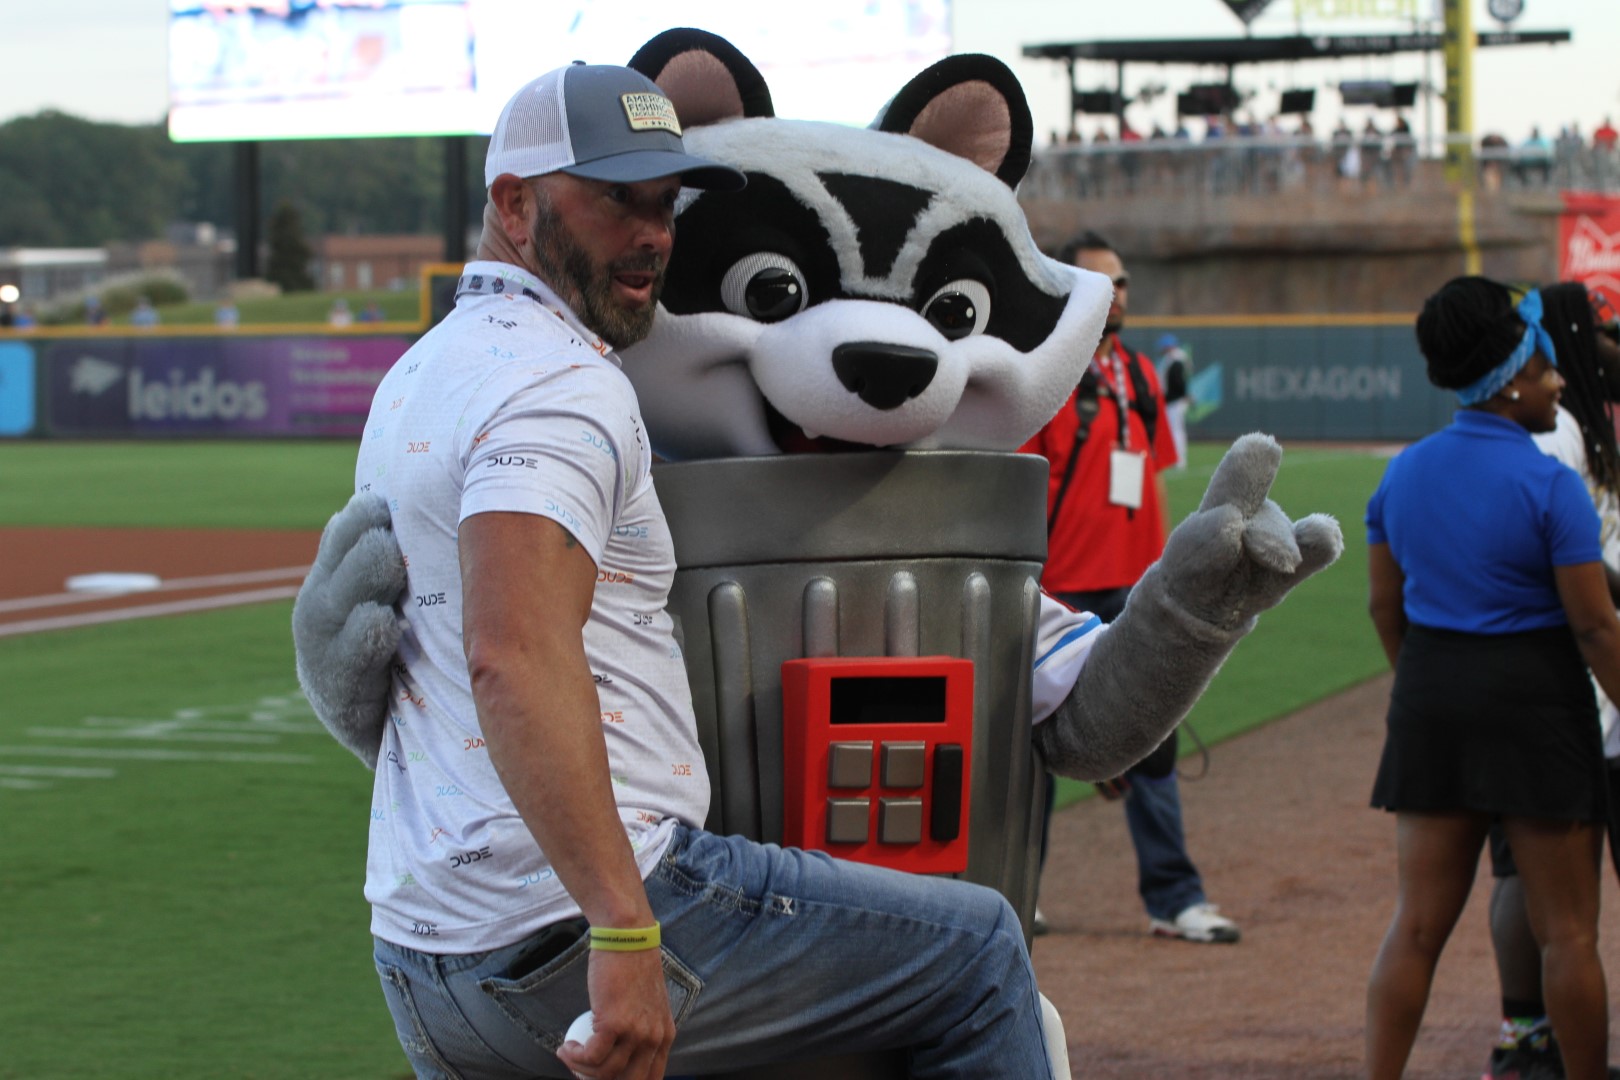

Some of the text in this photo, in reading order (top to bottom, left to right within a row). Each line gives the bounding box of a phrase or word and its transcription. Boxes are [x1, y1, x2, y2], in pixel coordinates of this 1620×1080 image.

[1235, 366, 1401, 399] HEXAGON
[129, 367, 267, 420] leidos
[406, 441, 431, 453] DUDE
[486, 456, 539, 470] DUDE
[544, 499, 582, 533] DUDE
[597, 570, 635, 585] DUDE
[416, 592, 447, 607] DUDE
[464, 738, 485, 750] DUD
[672, 763, 692, 776] DUDE
[450, 846, 493, 868] DUDE
[517, 867, 557, 889] DUD
[410, 922, 439, 936] DUDE
